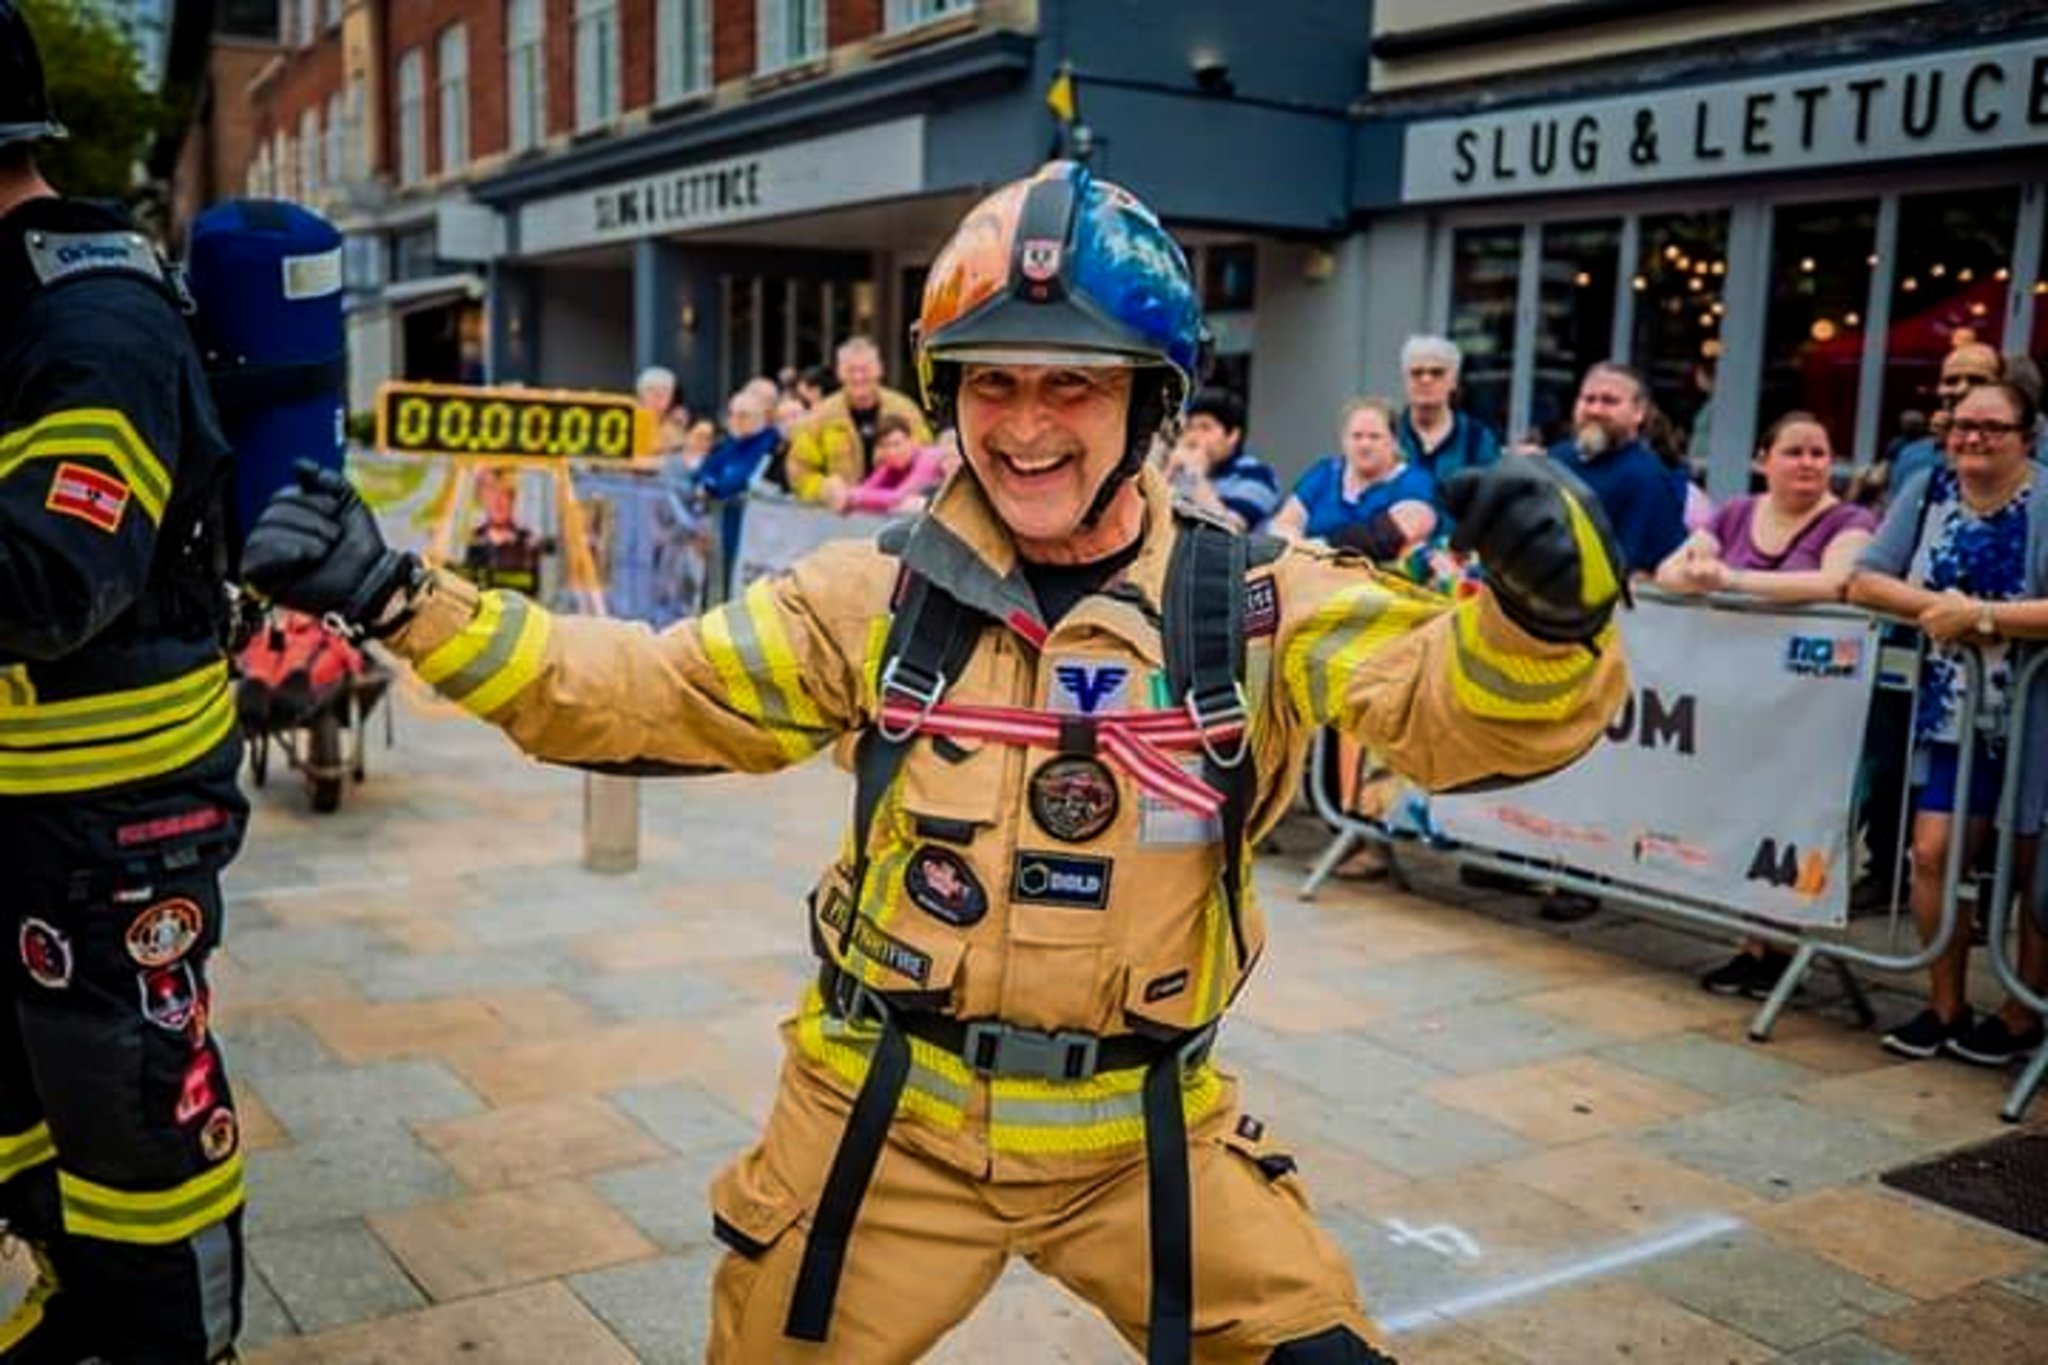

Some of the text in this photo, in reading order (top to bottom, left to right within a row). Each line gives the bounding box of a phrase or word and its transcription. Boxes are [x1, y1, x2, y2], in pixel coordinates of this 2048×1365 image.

[1453, 54, 2048, 184] SLUG & LETTUCE
